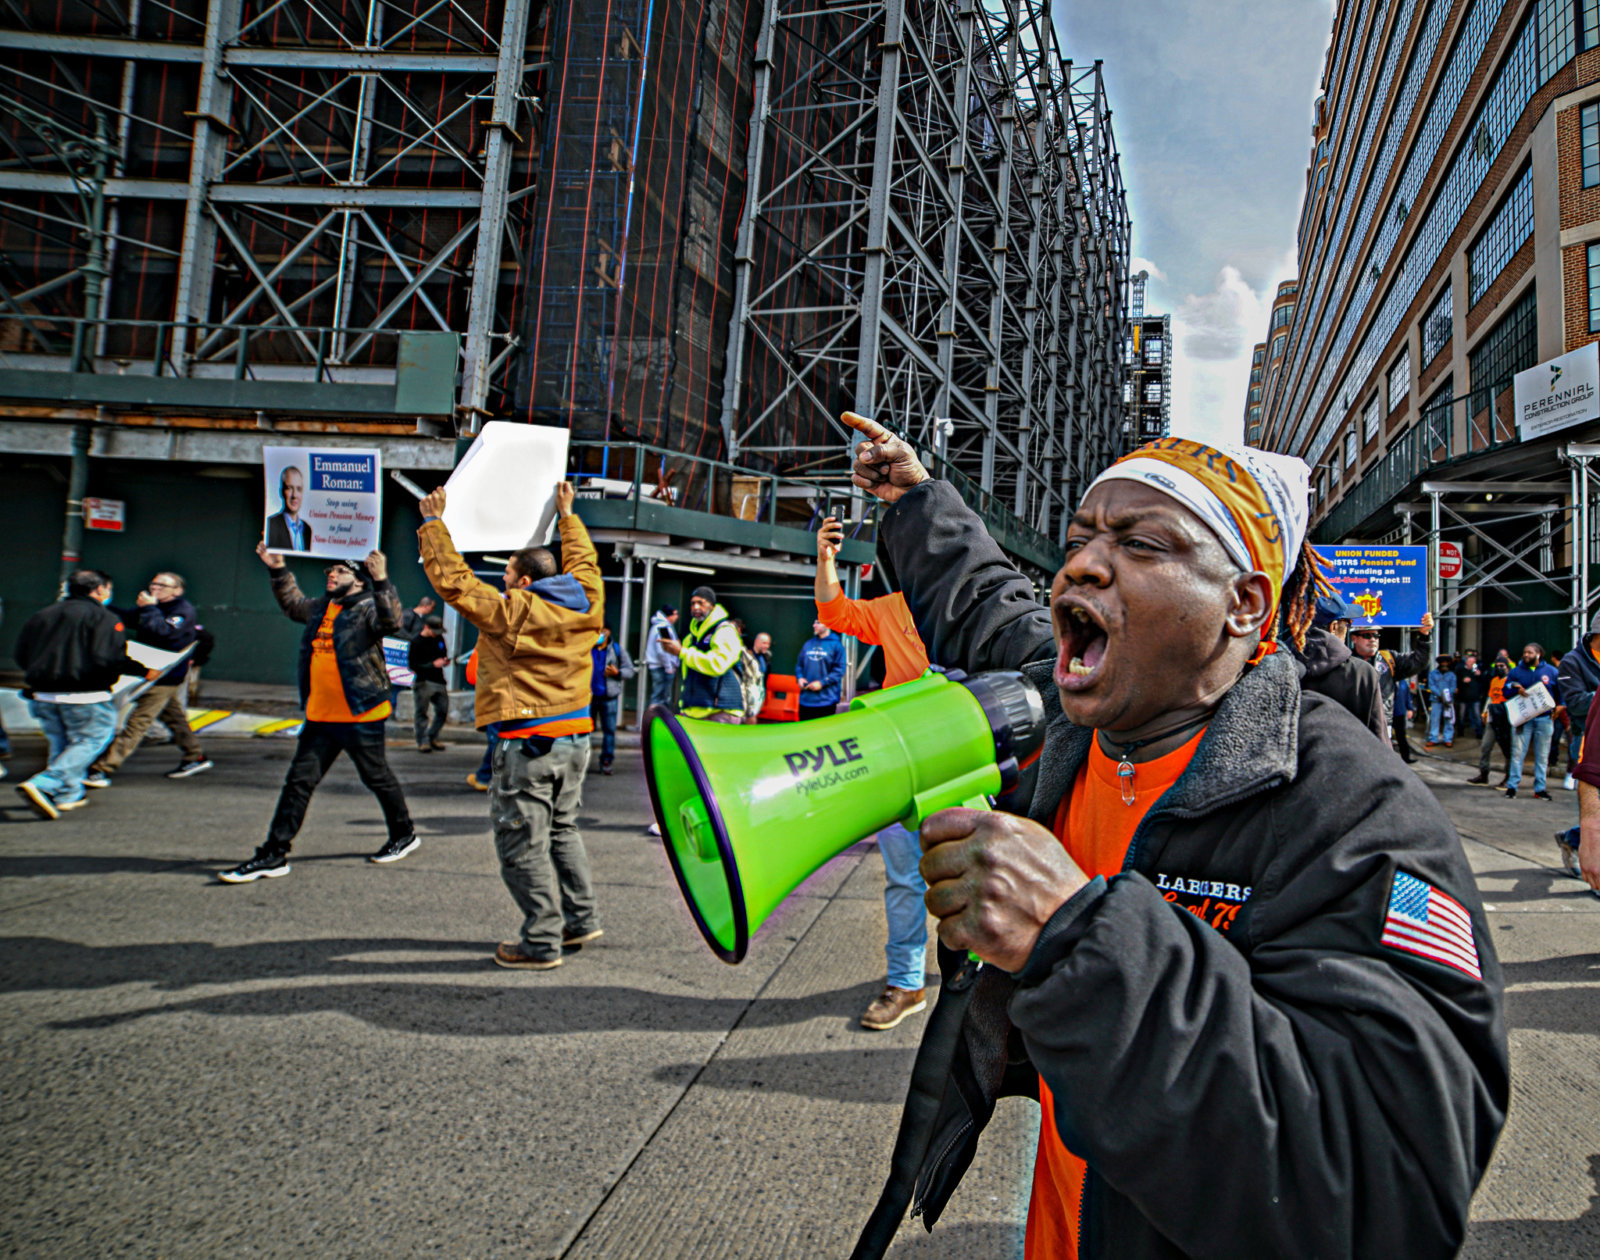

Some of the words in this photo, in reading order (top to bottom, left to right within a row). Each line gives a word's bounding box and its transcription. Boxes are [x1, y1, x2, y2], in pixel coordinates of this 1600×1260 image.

[1524, 383, 1594, 414] PERENNIAL
[1524, 402, 1570, 420] CONSTRUCTION
[1571, 391, 1594, 405] GROUP
[313, 457, 371, 473] Emmanuel
[322, 474, 363, 490] Roman:
[326, 498, 340, 509] Stop
[341, 499, 358, 510] using
[309, 509, 328, 519] Union
[329, 511, 353, 520] Pension
[354, 512, 375, 524] Money
[336, 524, 352, 534] fund
[313, 534, 347, 545] Non-Union
[1349, 568, 1382, 576] Funding
[1369, 577, 1400, 585] Project
[783, 737, 863, 778] PYLE
[796, 766, 870, 797] PyleUSA.com
